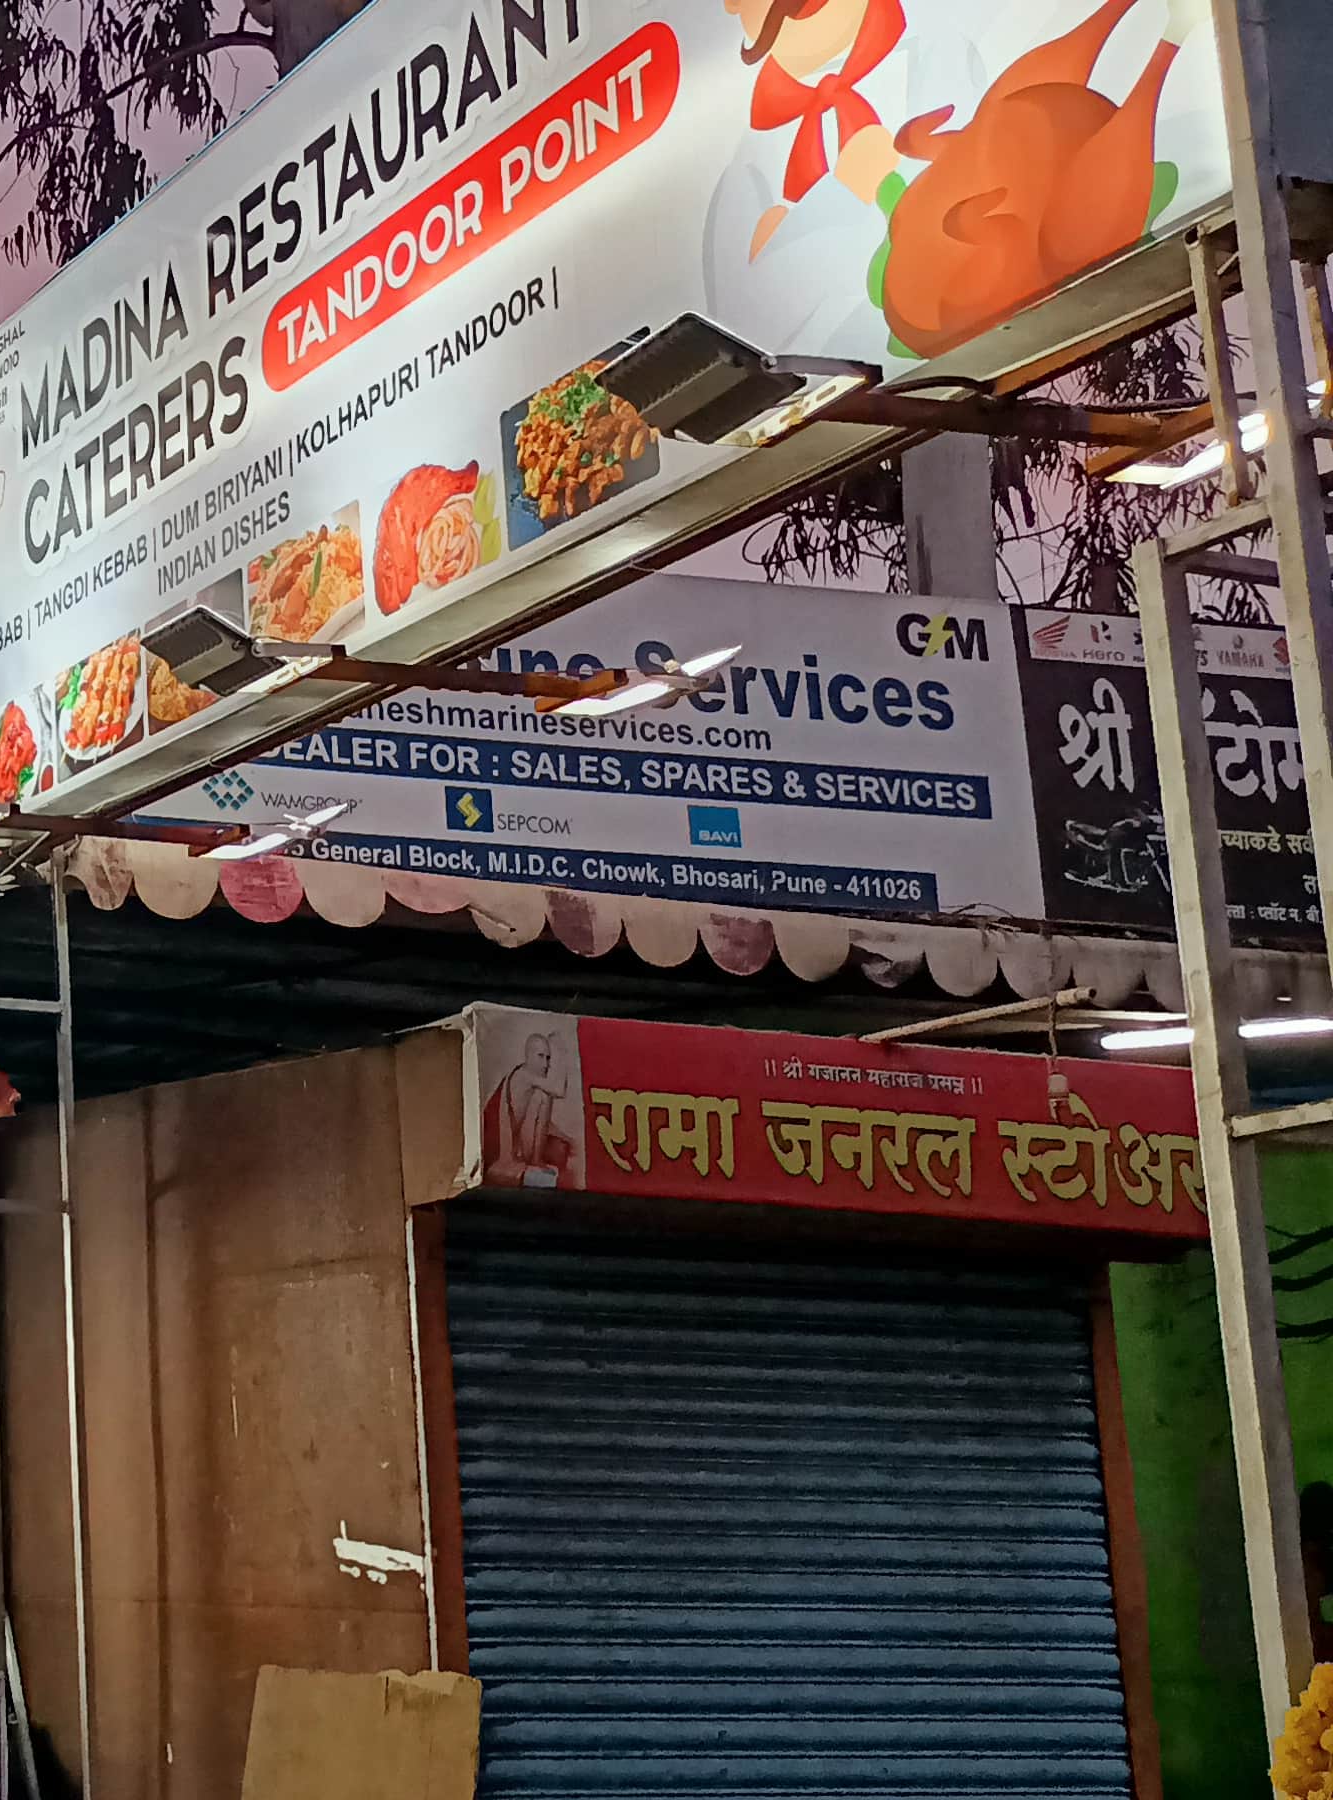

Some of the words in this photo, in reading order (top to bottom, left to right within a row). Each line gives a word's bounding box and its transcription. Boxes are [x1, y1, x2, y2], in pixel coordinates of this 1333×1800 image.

[277, 180, 483, 366] TANDOOR
[500, 49, 652, 215] POINT
[20, 259, 189, 460] MADINA
[24, 335, 249, 565] CATERERS
[34, 576, 89, 627] TANGDI
[92, 534, 149, 593] KEBAB
[161, 499, 200, 549] DUM
[204, 446, 284, 523] BIRIYANI
[296, 357, 420, 464] KOLHAPURI
[425, 276, 545, 379] TANDOOR
[157, 535, 216, 596] INDIAN
[221, 490, 290, 558] DISHES
[409, 742, 481, 777] FOR
[510, 751, 631, 791] SALES,
[641, 759, 773, 798] SPARES
[783, 769, 807, 799] &
[815, 771, 977, 811] SERVICES
[1058, 677, 1135, 793] श्री
[311, 837, 402, 867] General
[409, 844, 481, 875] Block,
[487, 850, 575, 880] M.I.D.C.
[582, 857, 665, 888] Chowk,
[672, 863, 766, 895] Bhosari,
[772, 870, 827, 895] Pune
[846, 874, 922, 901] 411026
[497, 813, 571, 835] SEPCOM
[782, 1056, 803, 1079] श्री
[807, 1063, 862, 1084] गजानन
[867, 1068, 924, 1089] महाराज
[590, 1087, 739, 1178] रामा
[762, 1100, 976, 1198] जनरल
